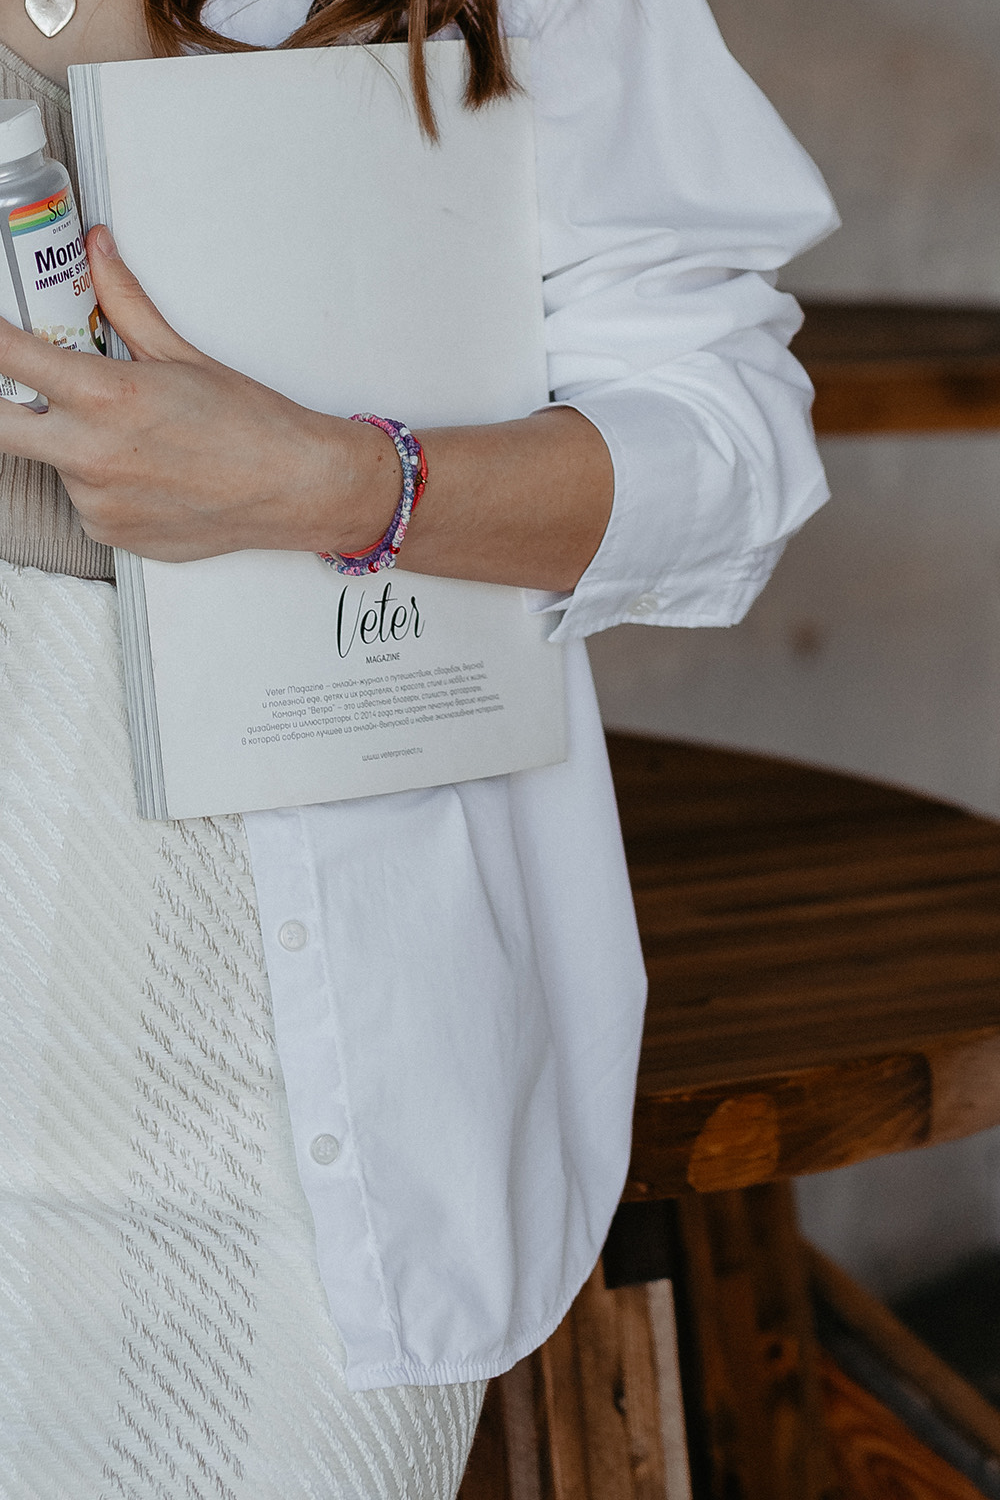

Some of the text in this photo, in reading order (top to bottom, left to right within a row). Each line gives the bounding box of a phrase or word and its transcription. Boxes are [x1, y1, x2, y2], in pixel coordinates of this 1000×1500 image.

[47, 195, 75, 222] SOL
[52, 220, 72, 235] DIETARY
[35, 266, 74, 290] IMMUNE
[72, 271, 91, 297] 500
[336, 582, 426, 659] Veter
[365, 652, 401, 665] MAGAZINE
[265, 687, 286, 697] Veter
[287, 683, 324, 696] Magazine
[332, 676, 384, 689] онлайн-журнал
[268, 696, 305, 708] полезной
[323, 693, 344, 704] детях
[271, 708, 307, 719] Команда
[344, 703, 356, 711] это
[357, 698, 392, 710] известные
[246, 722, 292, 735] дизайнеры
[360, 709, 377, 720] 2014
[377, 709, 393, 719] года
[248, 732, 281, 745] которой
[281, 730, 315, 742] собрано
[315, 726, 343, 738] лучшее
[344, 726, 353, 734] из
